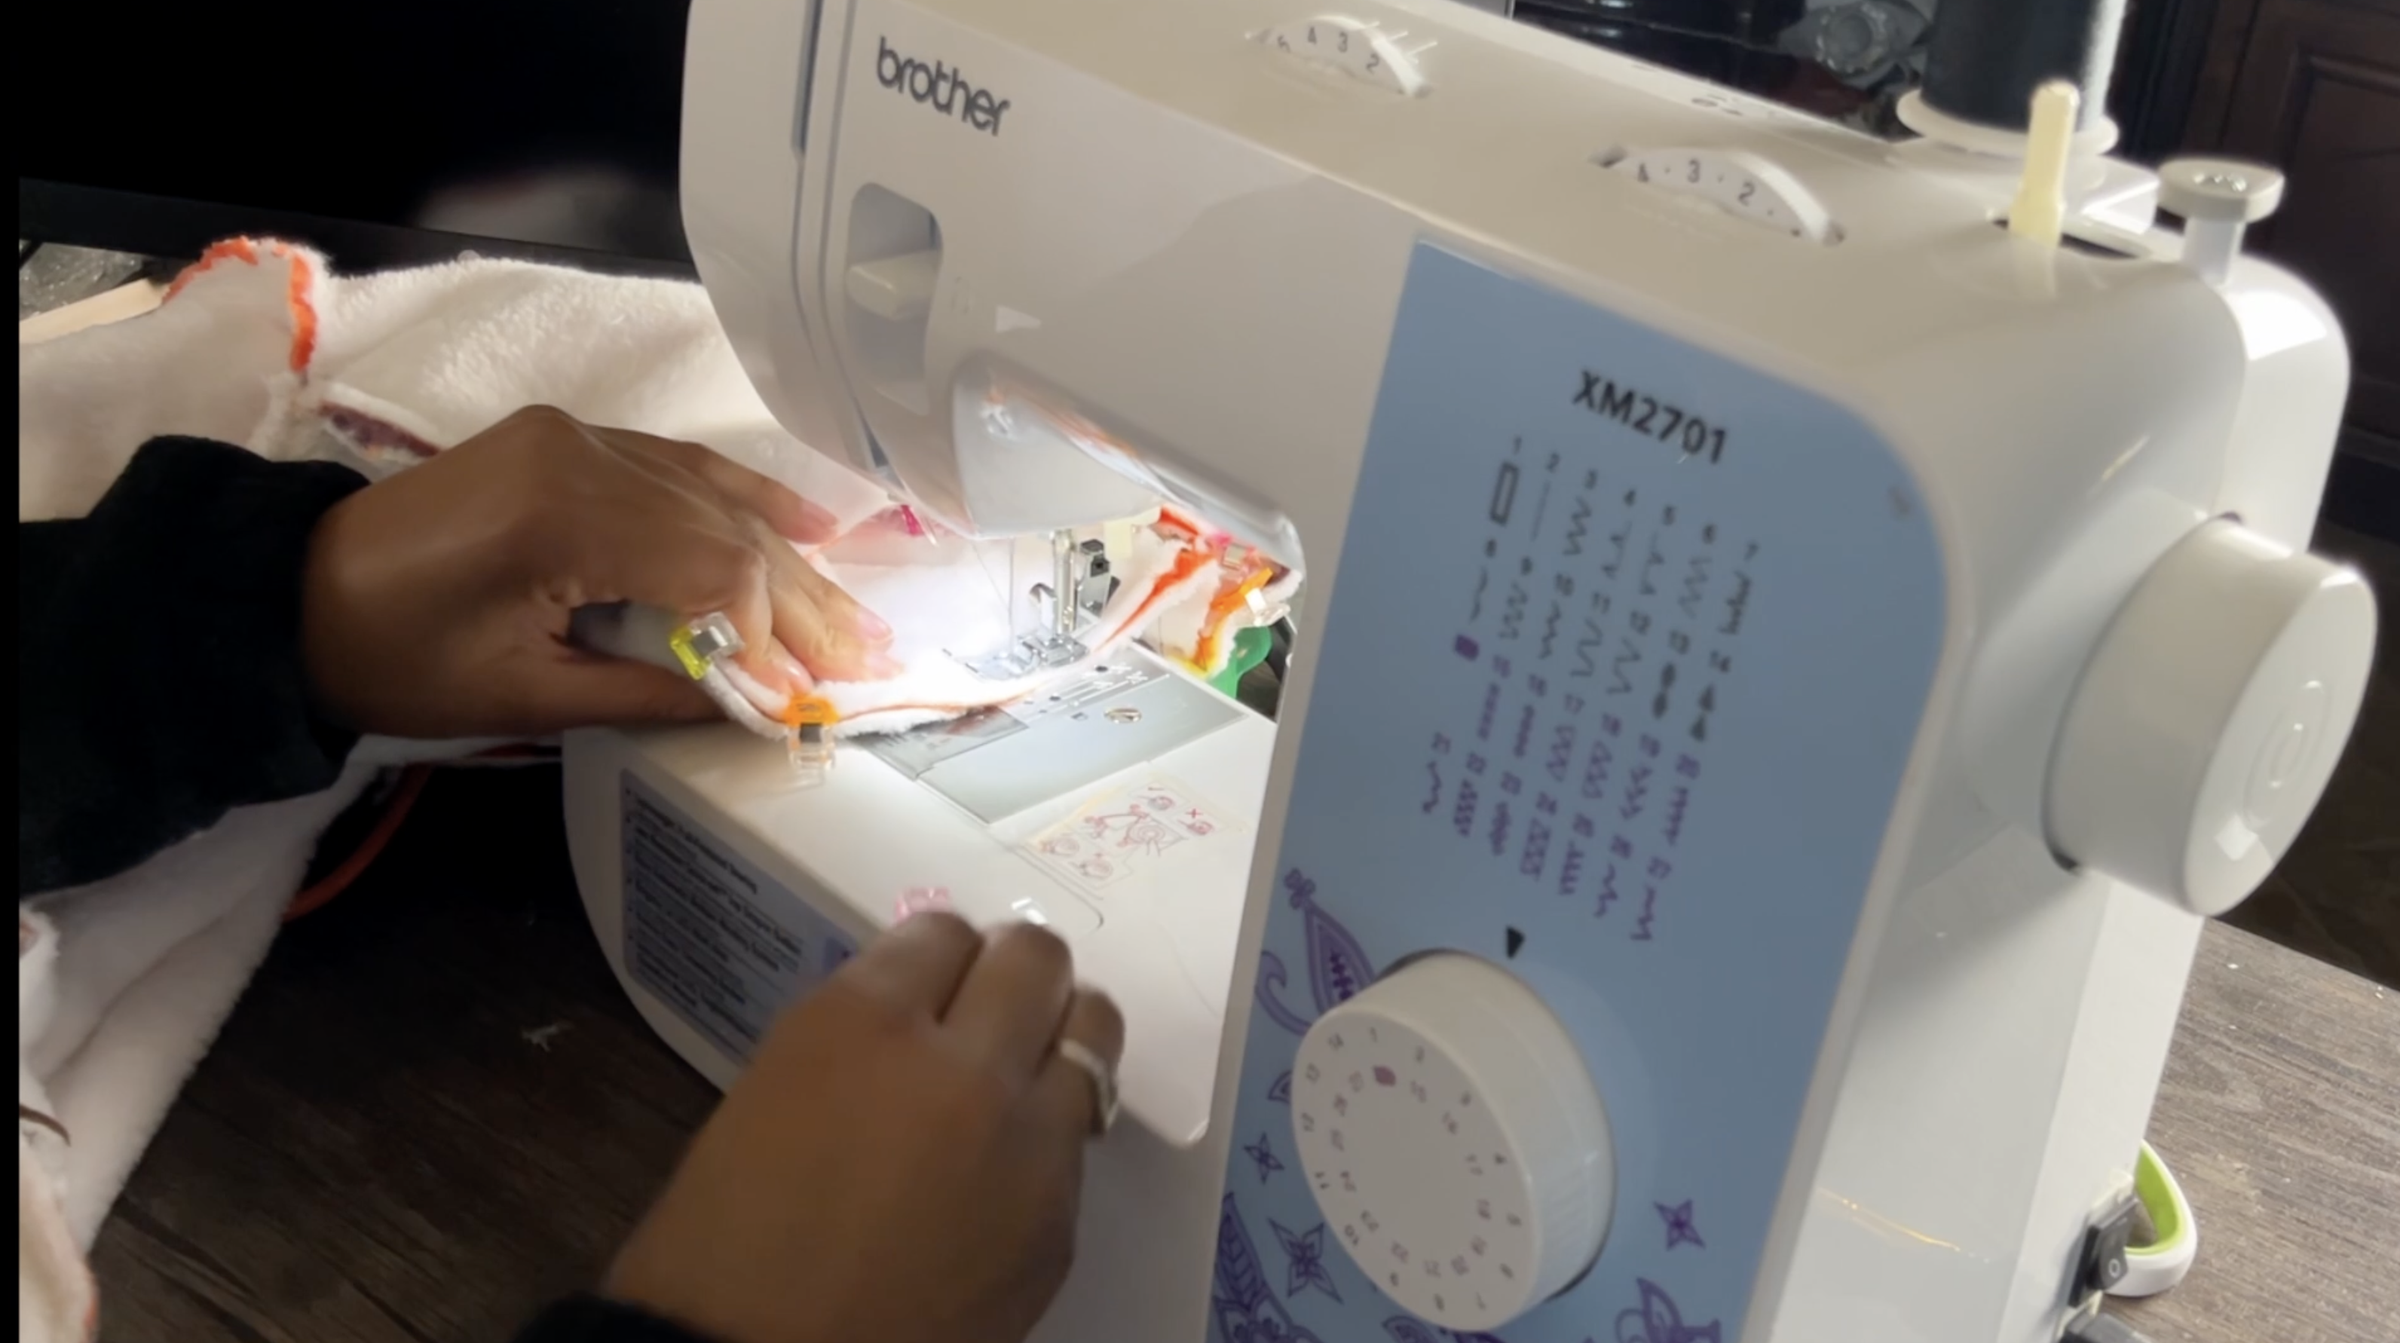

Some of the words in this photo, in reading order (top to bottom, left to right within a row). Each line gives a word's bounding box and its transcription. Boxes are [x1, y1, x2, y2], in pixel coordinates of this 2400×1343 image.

[876, 35, 1011, 137] brother
[1307, 26, 1318, 45] 4
[1337, 30, 1349, 53] 3
[1365, 53, 1380, 75] 2
[1637, 162, 1650, 183] 4
[1687, 157, 1702, 184] 3
[1737, 181, 1756, 207] 2
[1571, 369, 1727, 465] XM2701
